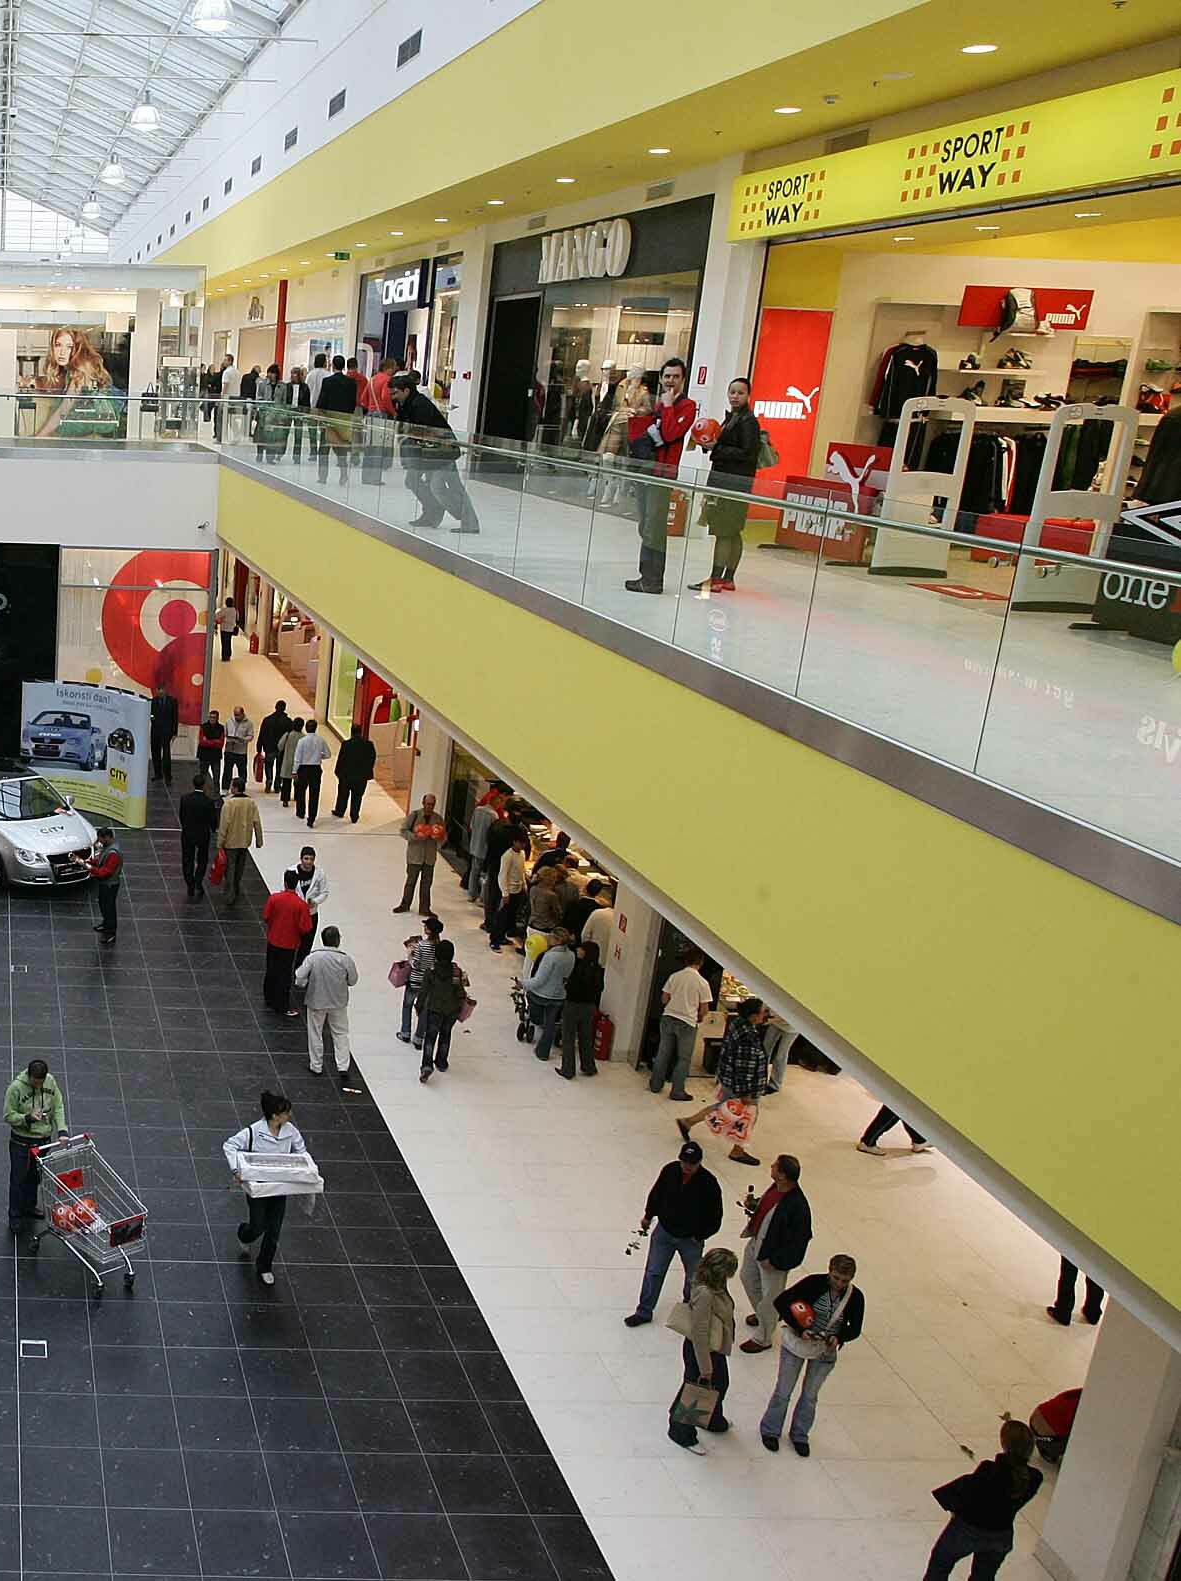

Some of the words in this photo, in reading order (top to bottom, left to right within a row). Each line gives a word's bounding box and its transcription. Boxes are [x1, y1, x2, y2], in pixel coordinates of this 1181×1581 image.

[940, 127, 1005, 164] SPORT
[767, 173, 810, 201] SPORT
[938, 162, 997, 195] WAY
[765, 201, 804, 227] WAY
[538, 218, 632, 284] MANGO
[1045, 313, 1076, 325] PUMA
[754, 400, 804, 419] PUMA
[1103, 572, 1170, 610] one
[109, 767, 128, 783] CITY
